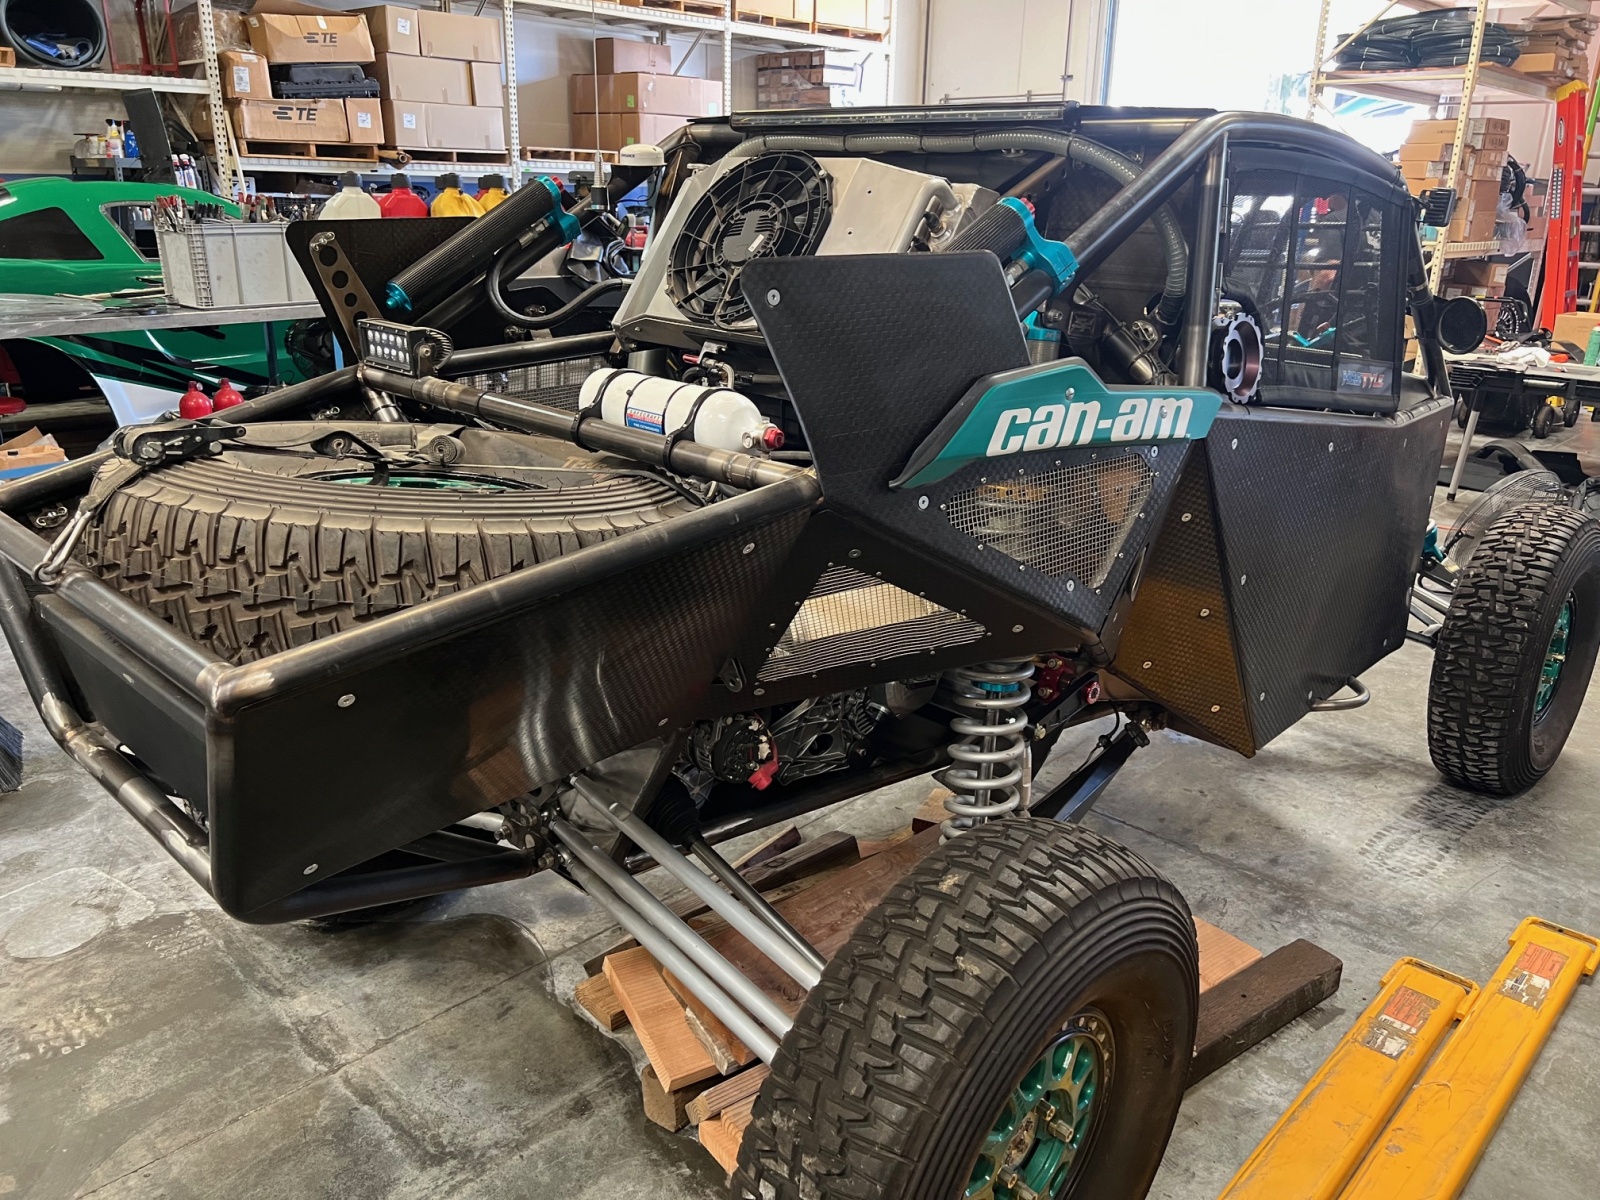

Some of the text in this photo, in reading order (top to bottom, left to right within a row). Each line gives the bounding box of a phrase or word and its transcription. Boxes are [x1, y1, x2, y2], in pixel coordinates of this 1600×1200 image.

[321, 32, 338, 44] TE
[296, 107, 318, 121] TE
[986, 397, 1193, 456] can-am
